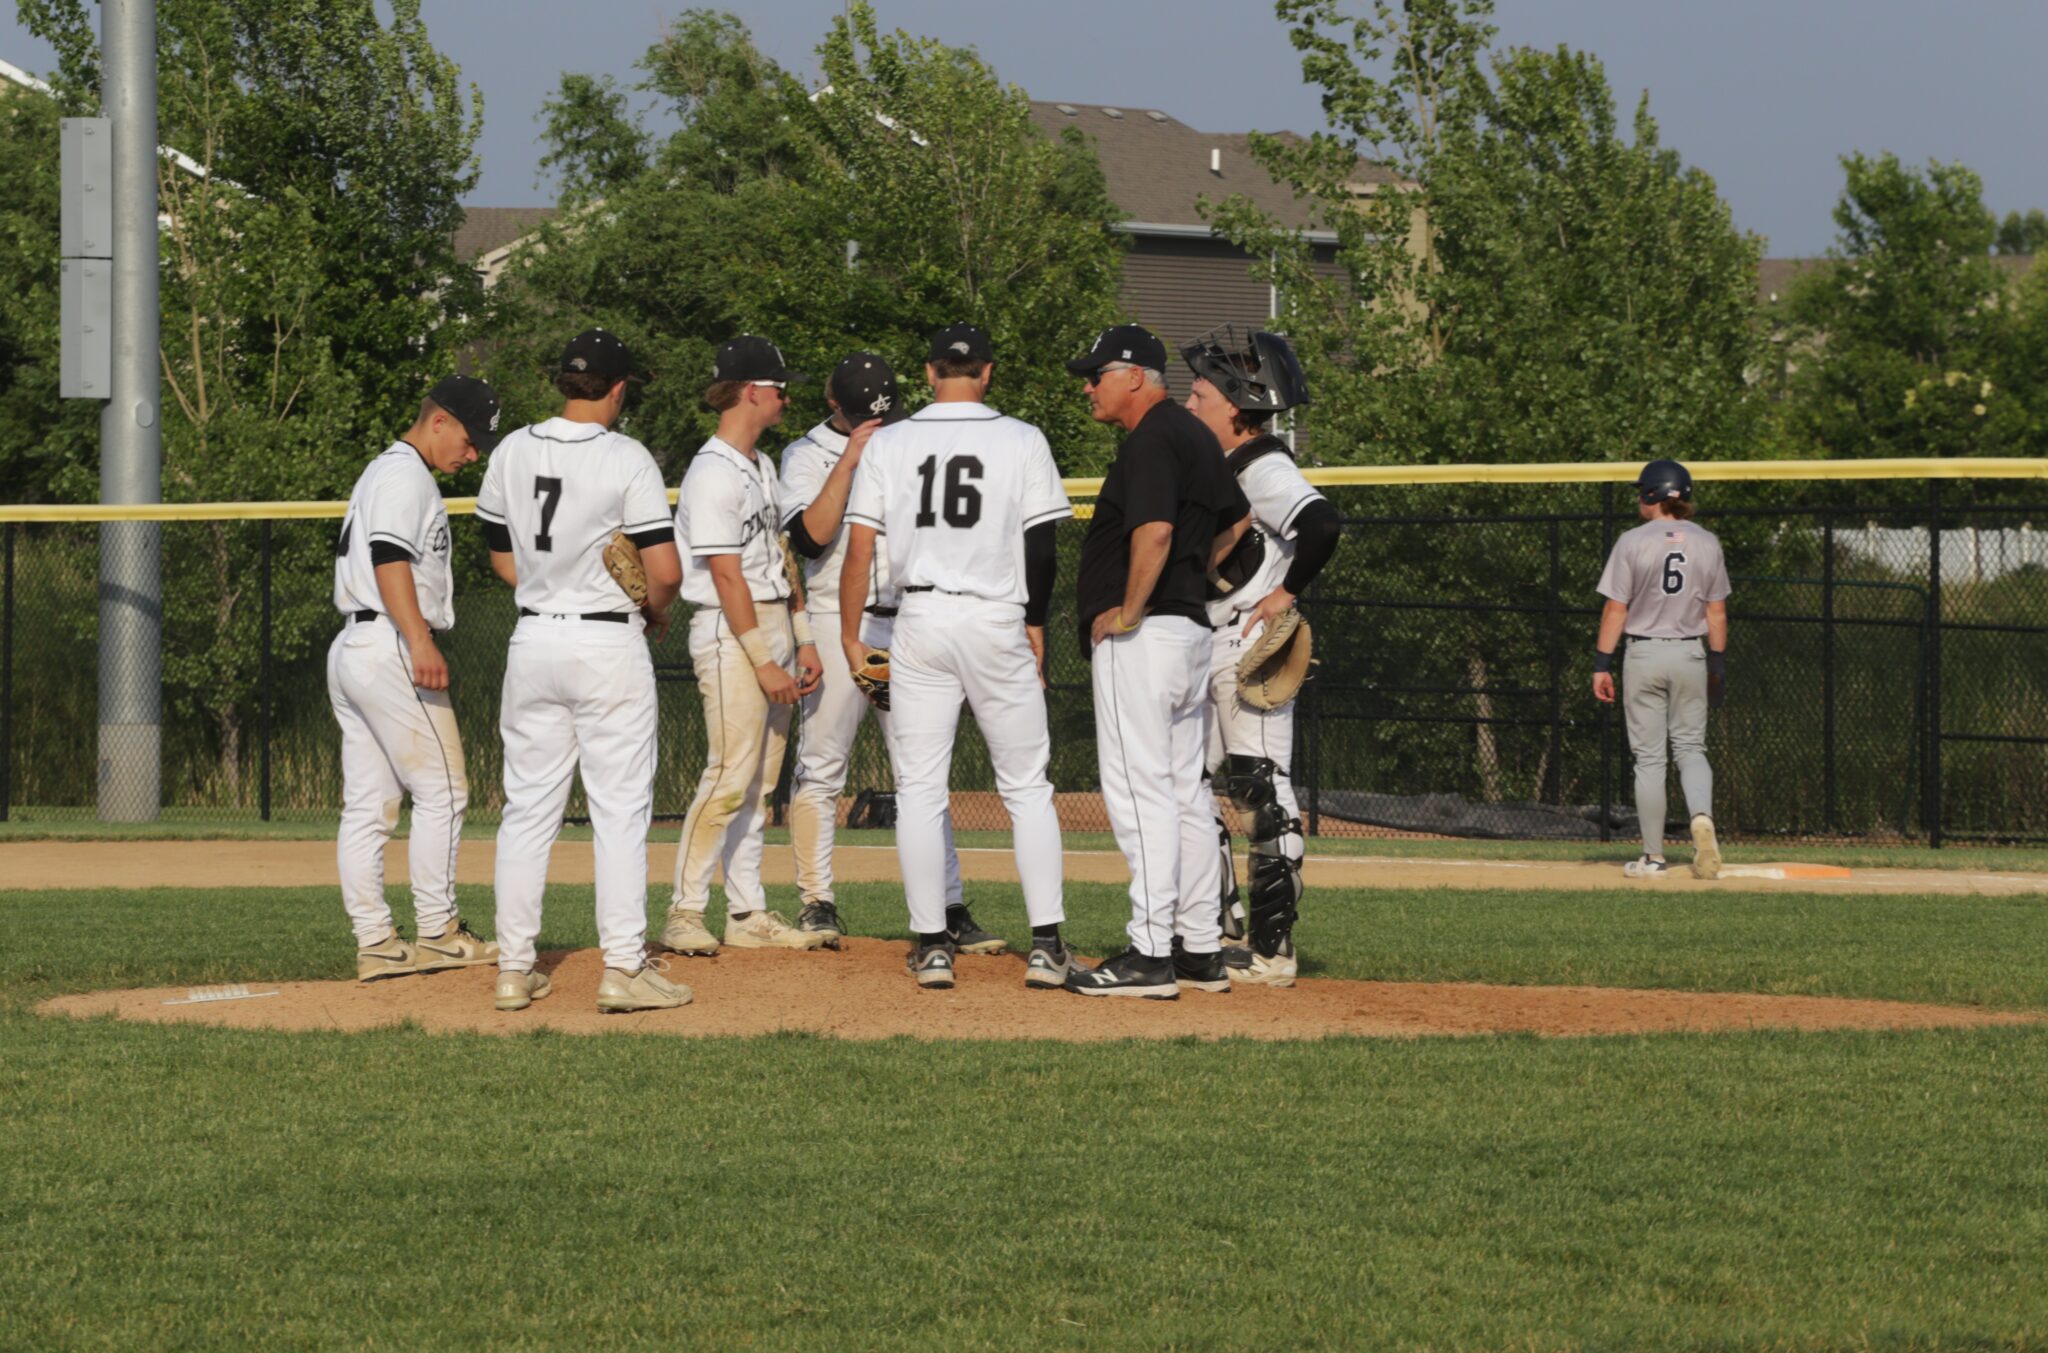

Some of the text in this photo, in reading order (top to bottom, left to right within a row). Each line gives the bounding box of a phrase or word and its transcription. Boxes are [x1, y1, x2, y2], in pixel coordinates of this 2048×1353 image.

[534, 475, 562, 552] 7
[916, 454, 984, 528] 16
[1662, 551, 1687, 596] 6
